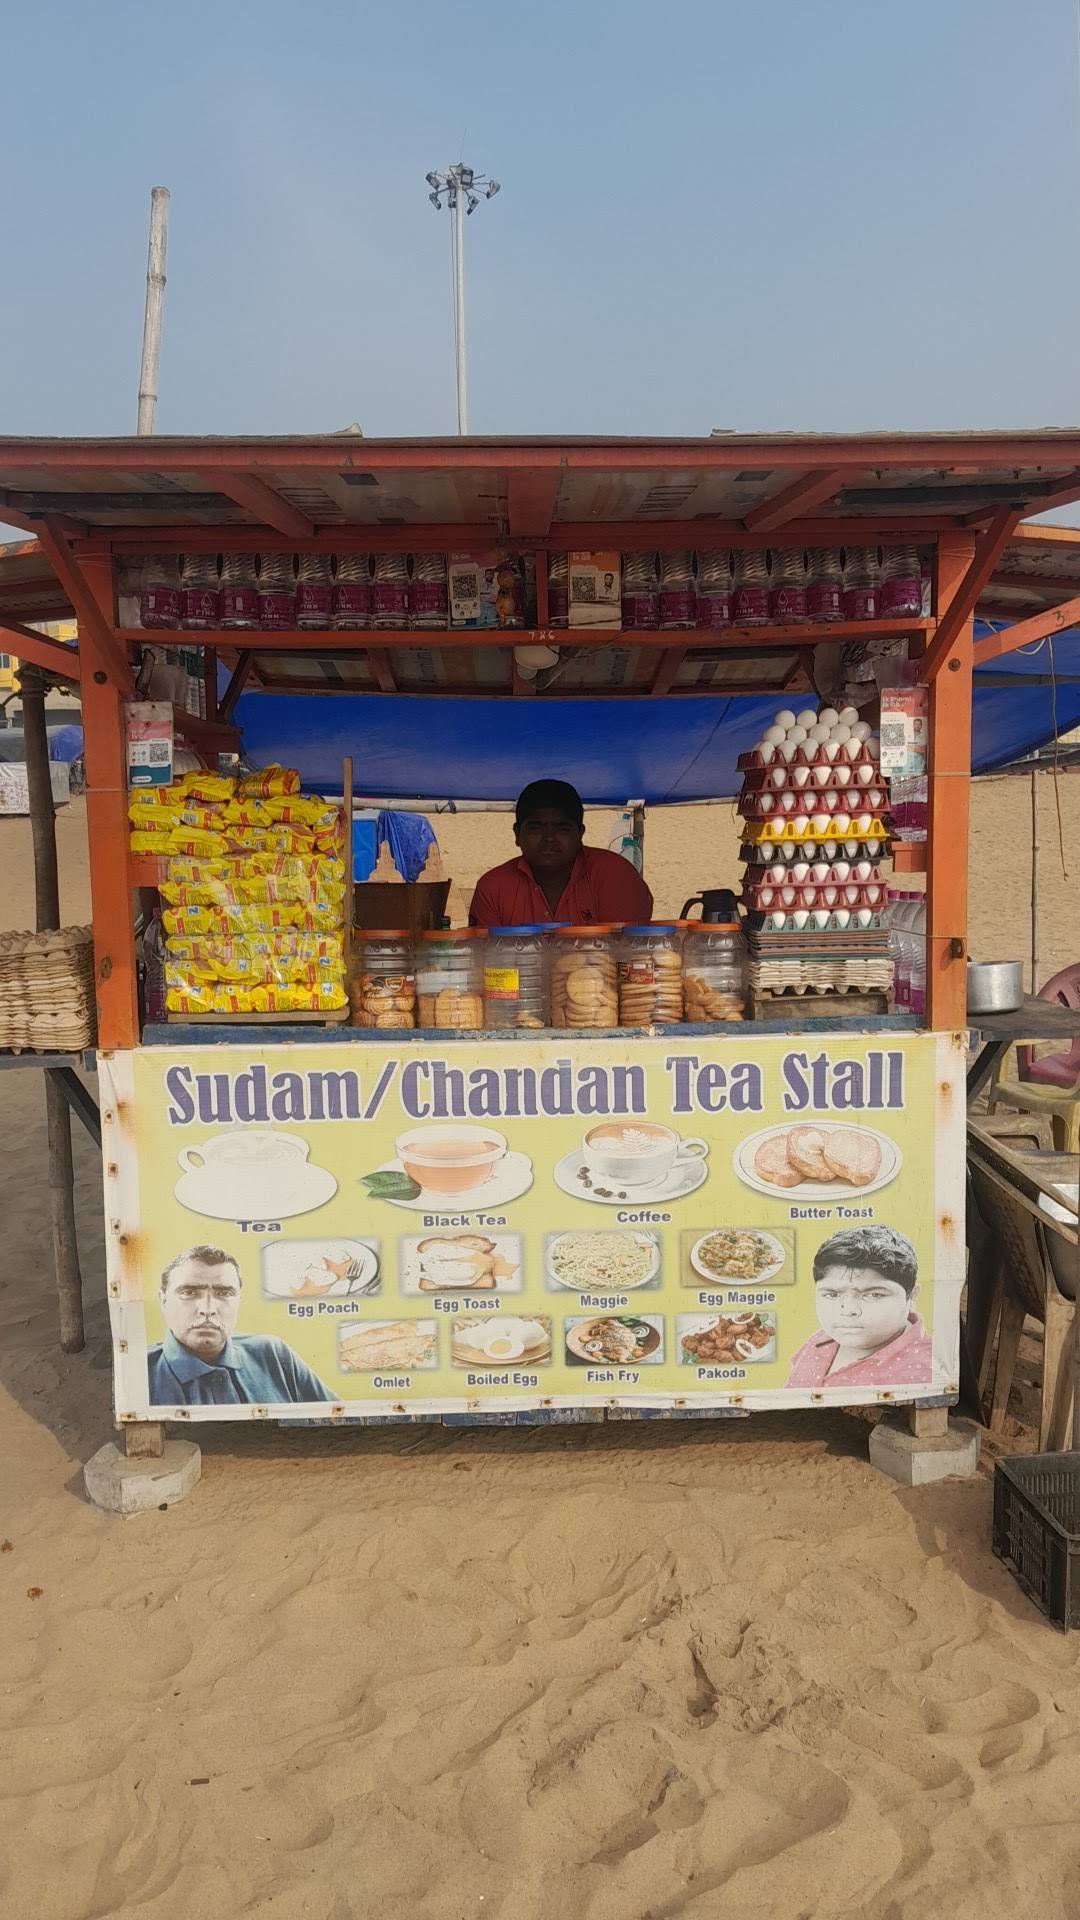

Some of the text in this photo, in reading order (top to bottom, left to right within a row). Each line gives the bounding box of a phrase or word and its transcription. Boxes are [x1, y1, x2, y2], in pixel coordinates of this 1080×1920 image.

[166, 1052, 904, 1125] Sudam/Chandan Tea Stall
[617, 1211, 672, 1223] Coffee
[790, 1206, 873, 1219] Butter Toast
[237, 1221, 282, 1233] Tea
[423, 1214, 507, 1227] Black Tea
[434, 1297, 500, 1312] Egg Toast
[580, 1295, 628, 1308] Maggie
[699, 1291, 776, 1306] Egg Maggie
[288, 1302, 359, 1317] Egg Poach
[587, 1370, 640, 1383] Fish Fry
[698, 1367, 746, 1379] Pakoda
[373, 1376, 411, 1388] Omlet
[467, 1374, 538, 1386] Boiled Egg
